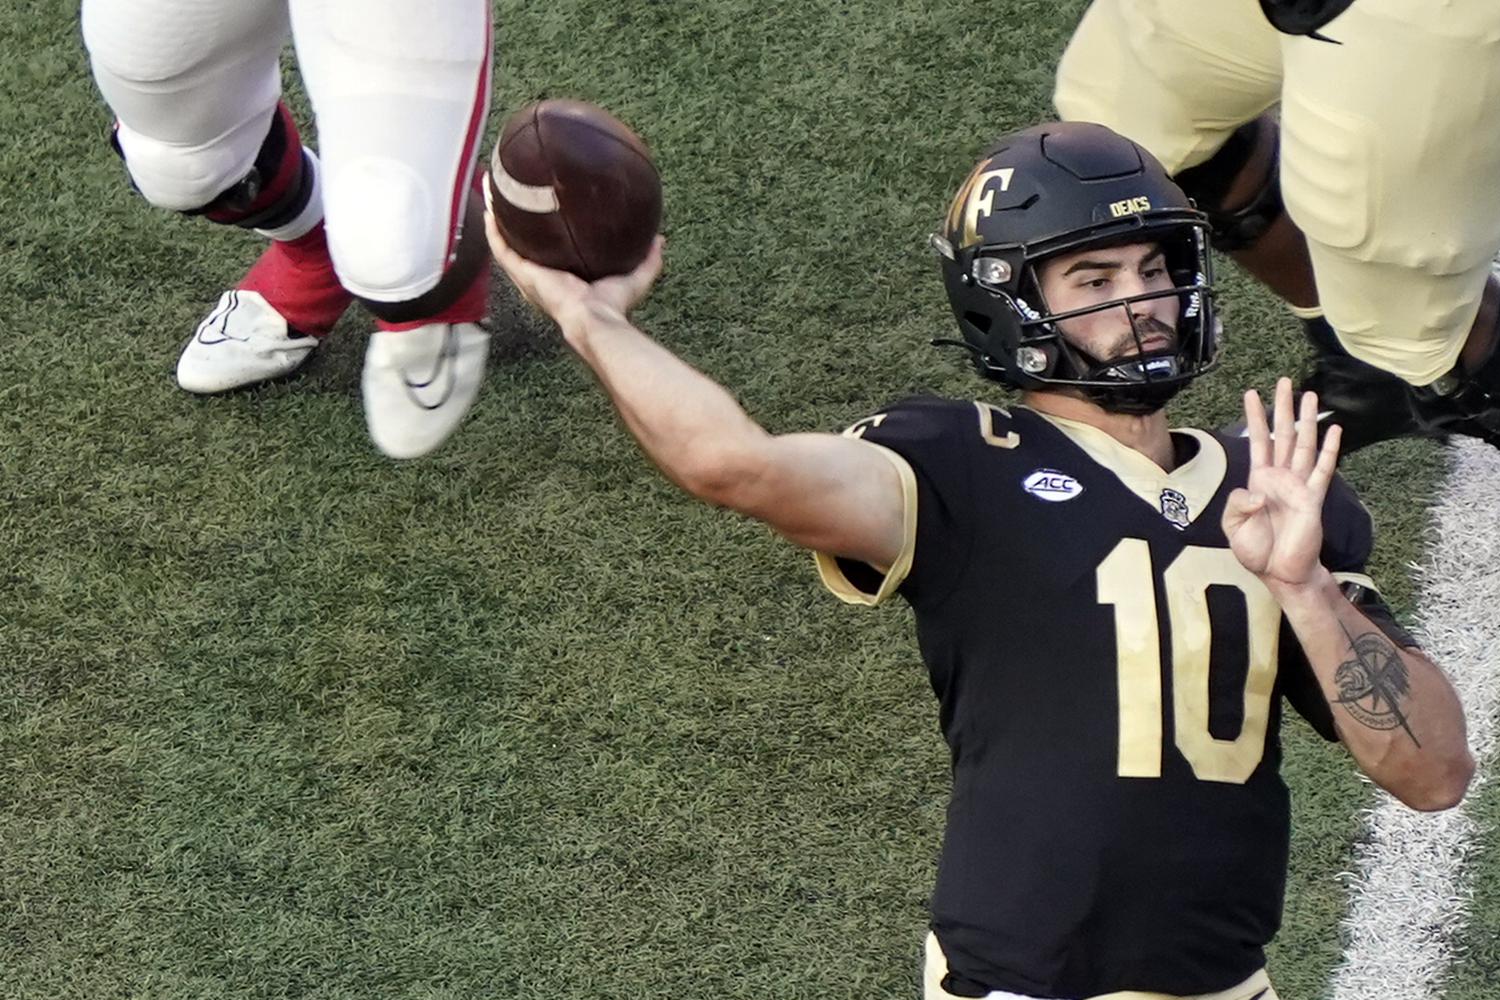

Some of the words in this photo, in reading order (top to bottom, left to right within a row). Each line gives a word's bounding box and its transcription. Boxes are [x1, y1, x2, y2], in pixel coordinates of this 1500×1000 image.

[1110, 196, 1152, 217] DEACS
[1032, 476, 1074, 491] ACC
[1096, 537, 1282, 784] 10
